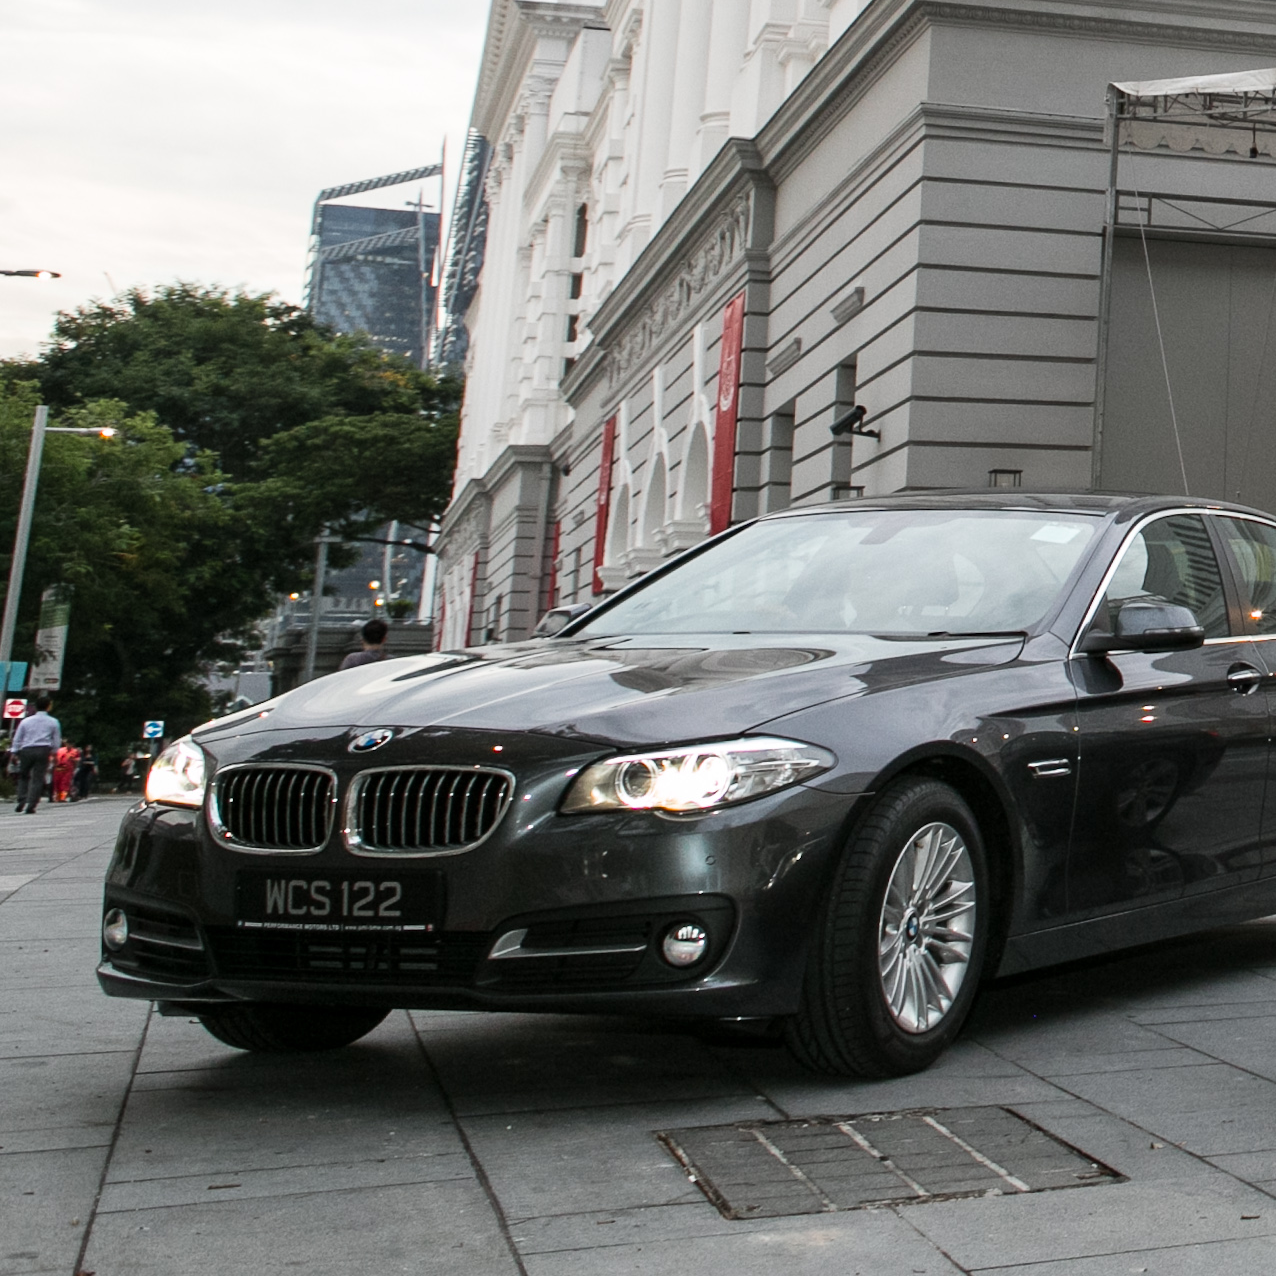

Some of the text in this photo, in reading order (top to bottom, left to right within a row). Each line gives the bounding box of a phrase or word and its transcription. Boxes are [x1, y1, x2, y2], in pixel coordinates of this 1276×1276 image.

[266, 879, 401, 917] WCS 122
[263, 922, 303, 930] PERFORMANCE
